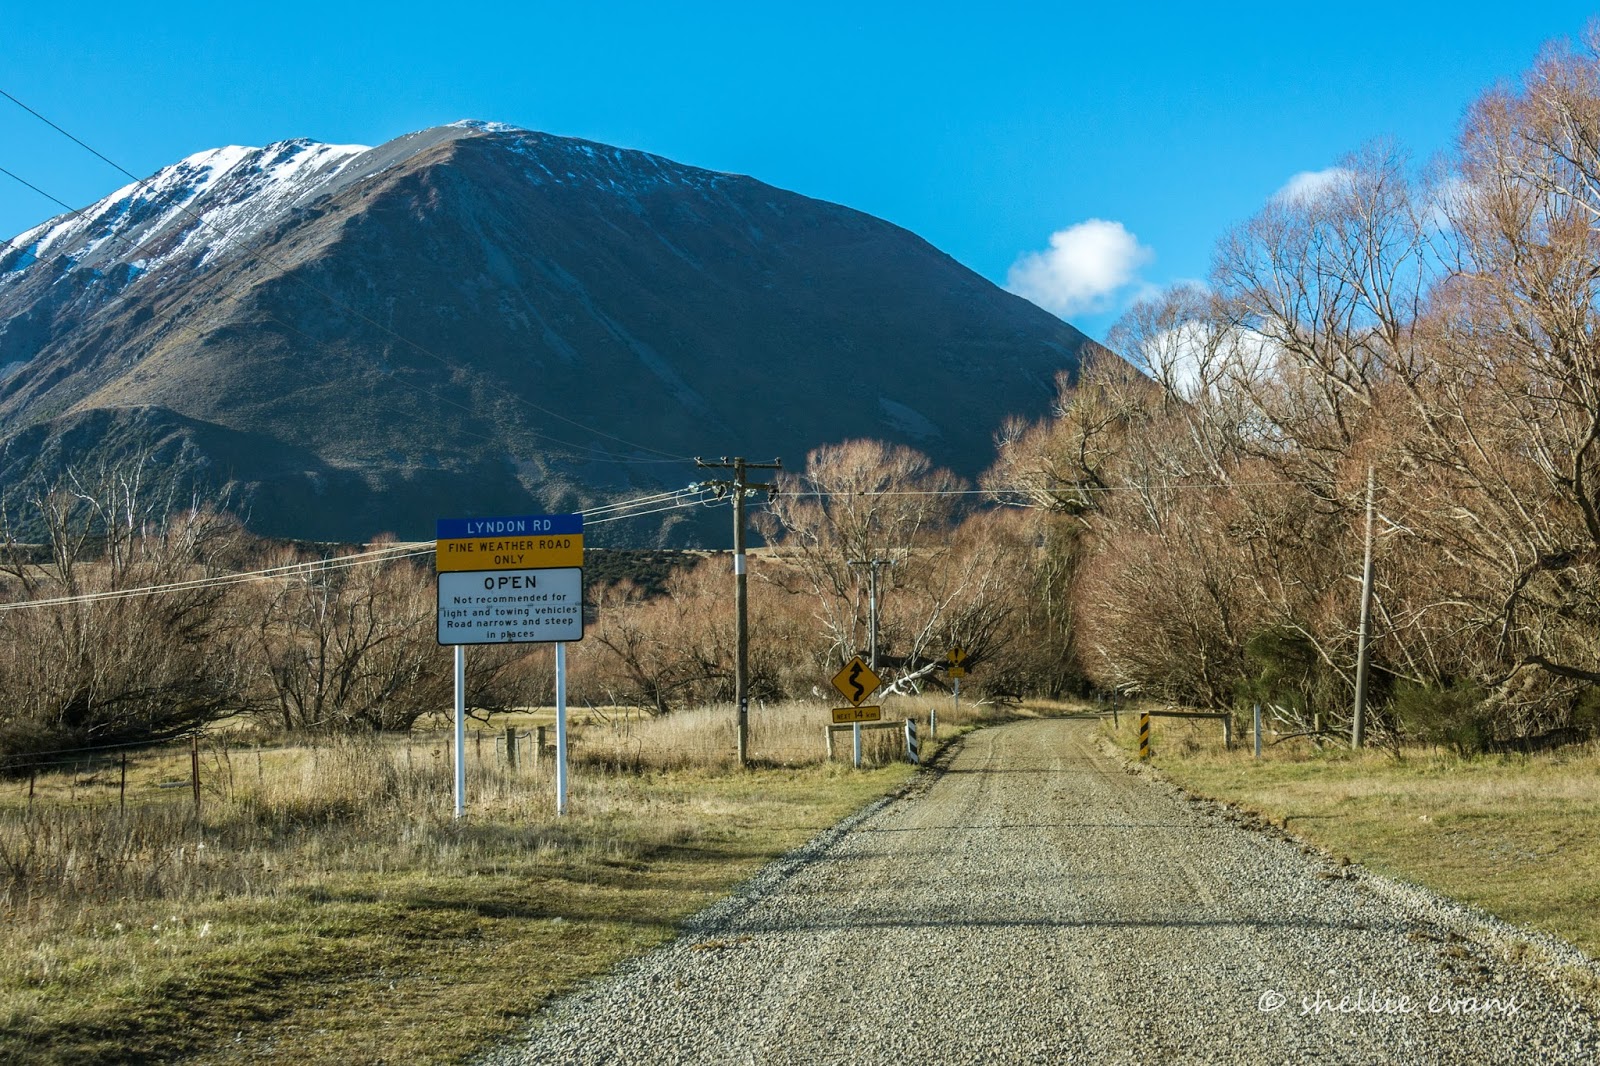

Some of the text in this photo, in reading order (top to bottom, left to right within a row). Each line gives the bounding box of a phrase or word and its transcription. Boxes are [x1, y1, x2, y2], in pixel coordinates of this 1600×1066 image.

[467, 519, 551, 534] LYNDON RD
[448, 539, 571, 552] FINE WEATHER ROAD
[494, 554, 524, 565] ONLY
[484, 575, 536, 590] OPEN
[453, 593, 567, 604] Not recommended for
[443, 606, 577, 619] light and towing vehicles
[447, 616, 574, 628] Road narrows and steep
[486, 630, 535, 640] in places
[854, 710, 863, 719] 14
